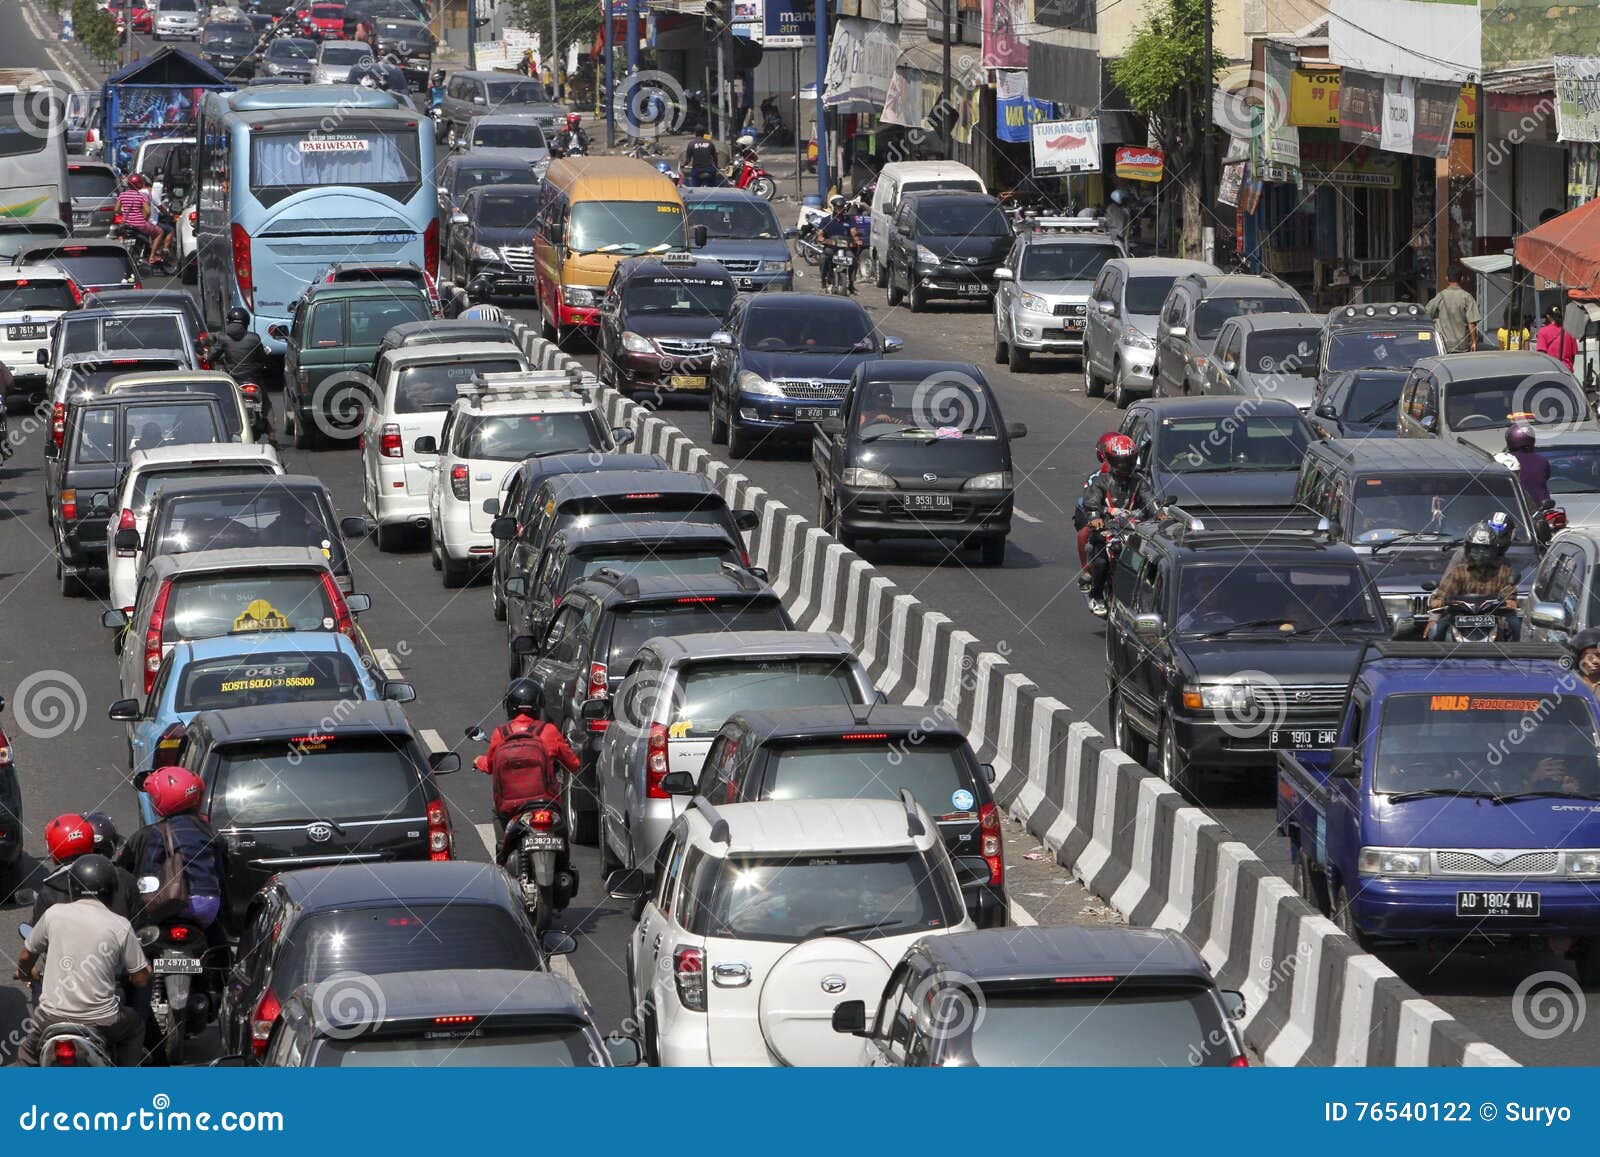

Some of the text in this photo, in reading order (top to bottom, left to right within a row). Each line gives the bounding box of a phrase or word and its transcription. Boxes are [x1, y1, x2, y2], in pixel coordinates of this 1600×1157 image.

[780, 23, 799, 33] atm
[1036, 122, 1094, 135] TUKANG GIGI
[303, 142, 364, 151] PARIWISATA
[905, 495, 910, 505] B
[245, 666, 286, 677] 043
[221, 677, 315, 692] KOSTI SOLO 856300
[1272, 732, 1279, 743] B
[1291, 732, 1311, 743] 1910
[1462, 893, 1533, 908] AD 1804 WA
